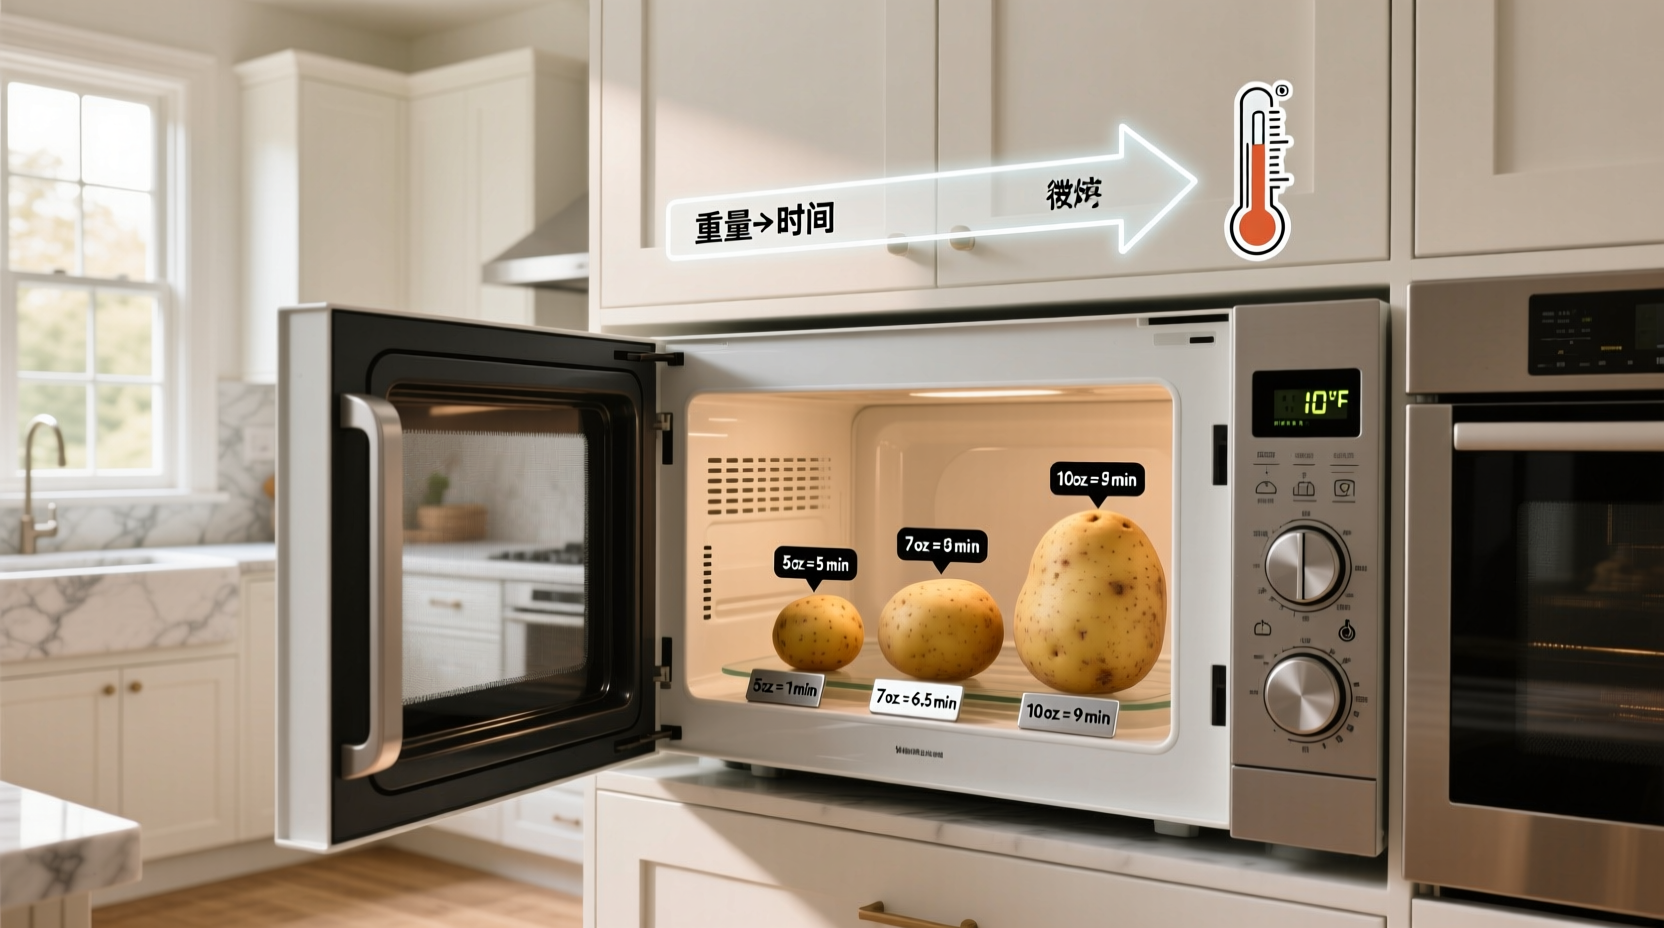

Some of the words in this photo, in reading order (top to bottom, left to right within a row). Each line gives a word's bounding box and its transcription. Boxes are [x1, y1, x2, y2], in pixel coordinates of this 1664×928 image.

[877, 688, 900, 705] 7oz
[933, 695, 957, 711] min
[1027, 703, 1060, 721] 10oz
[1084, 709, 1111, 726] min
